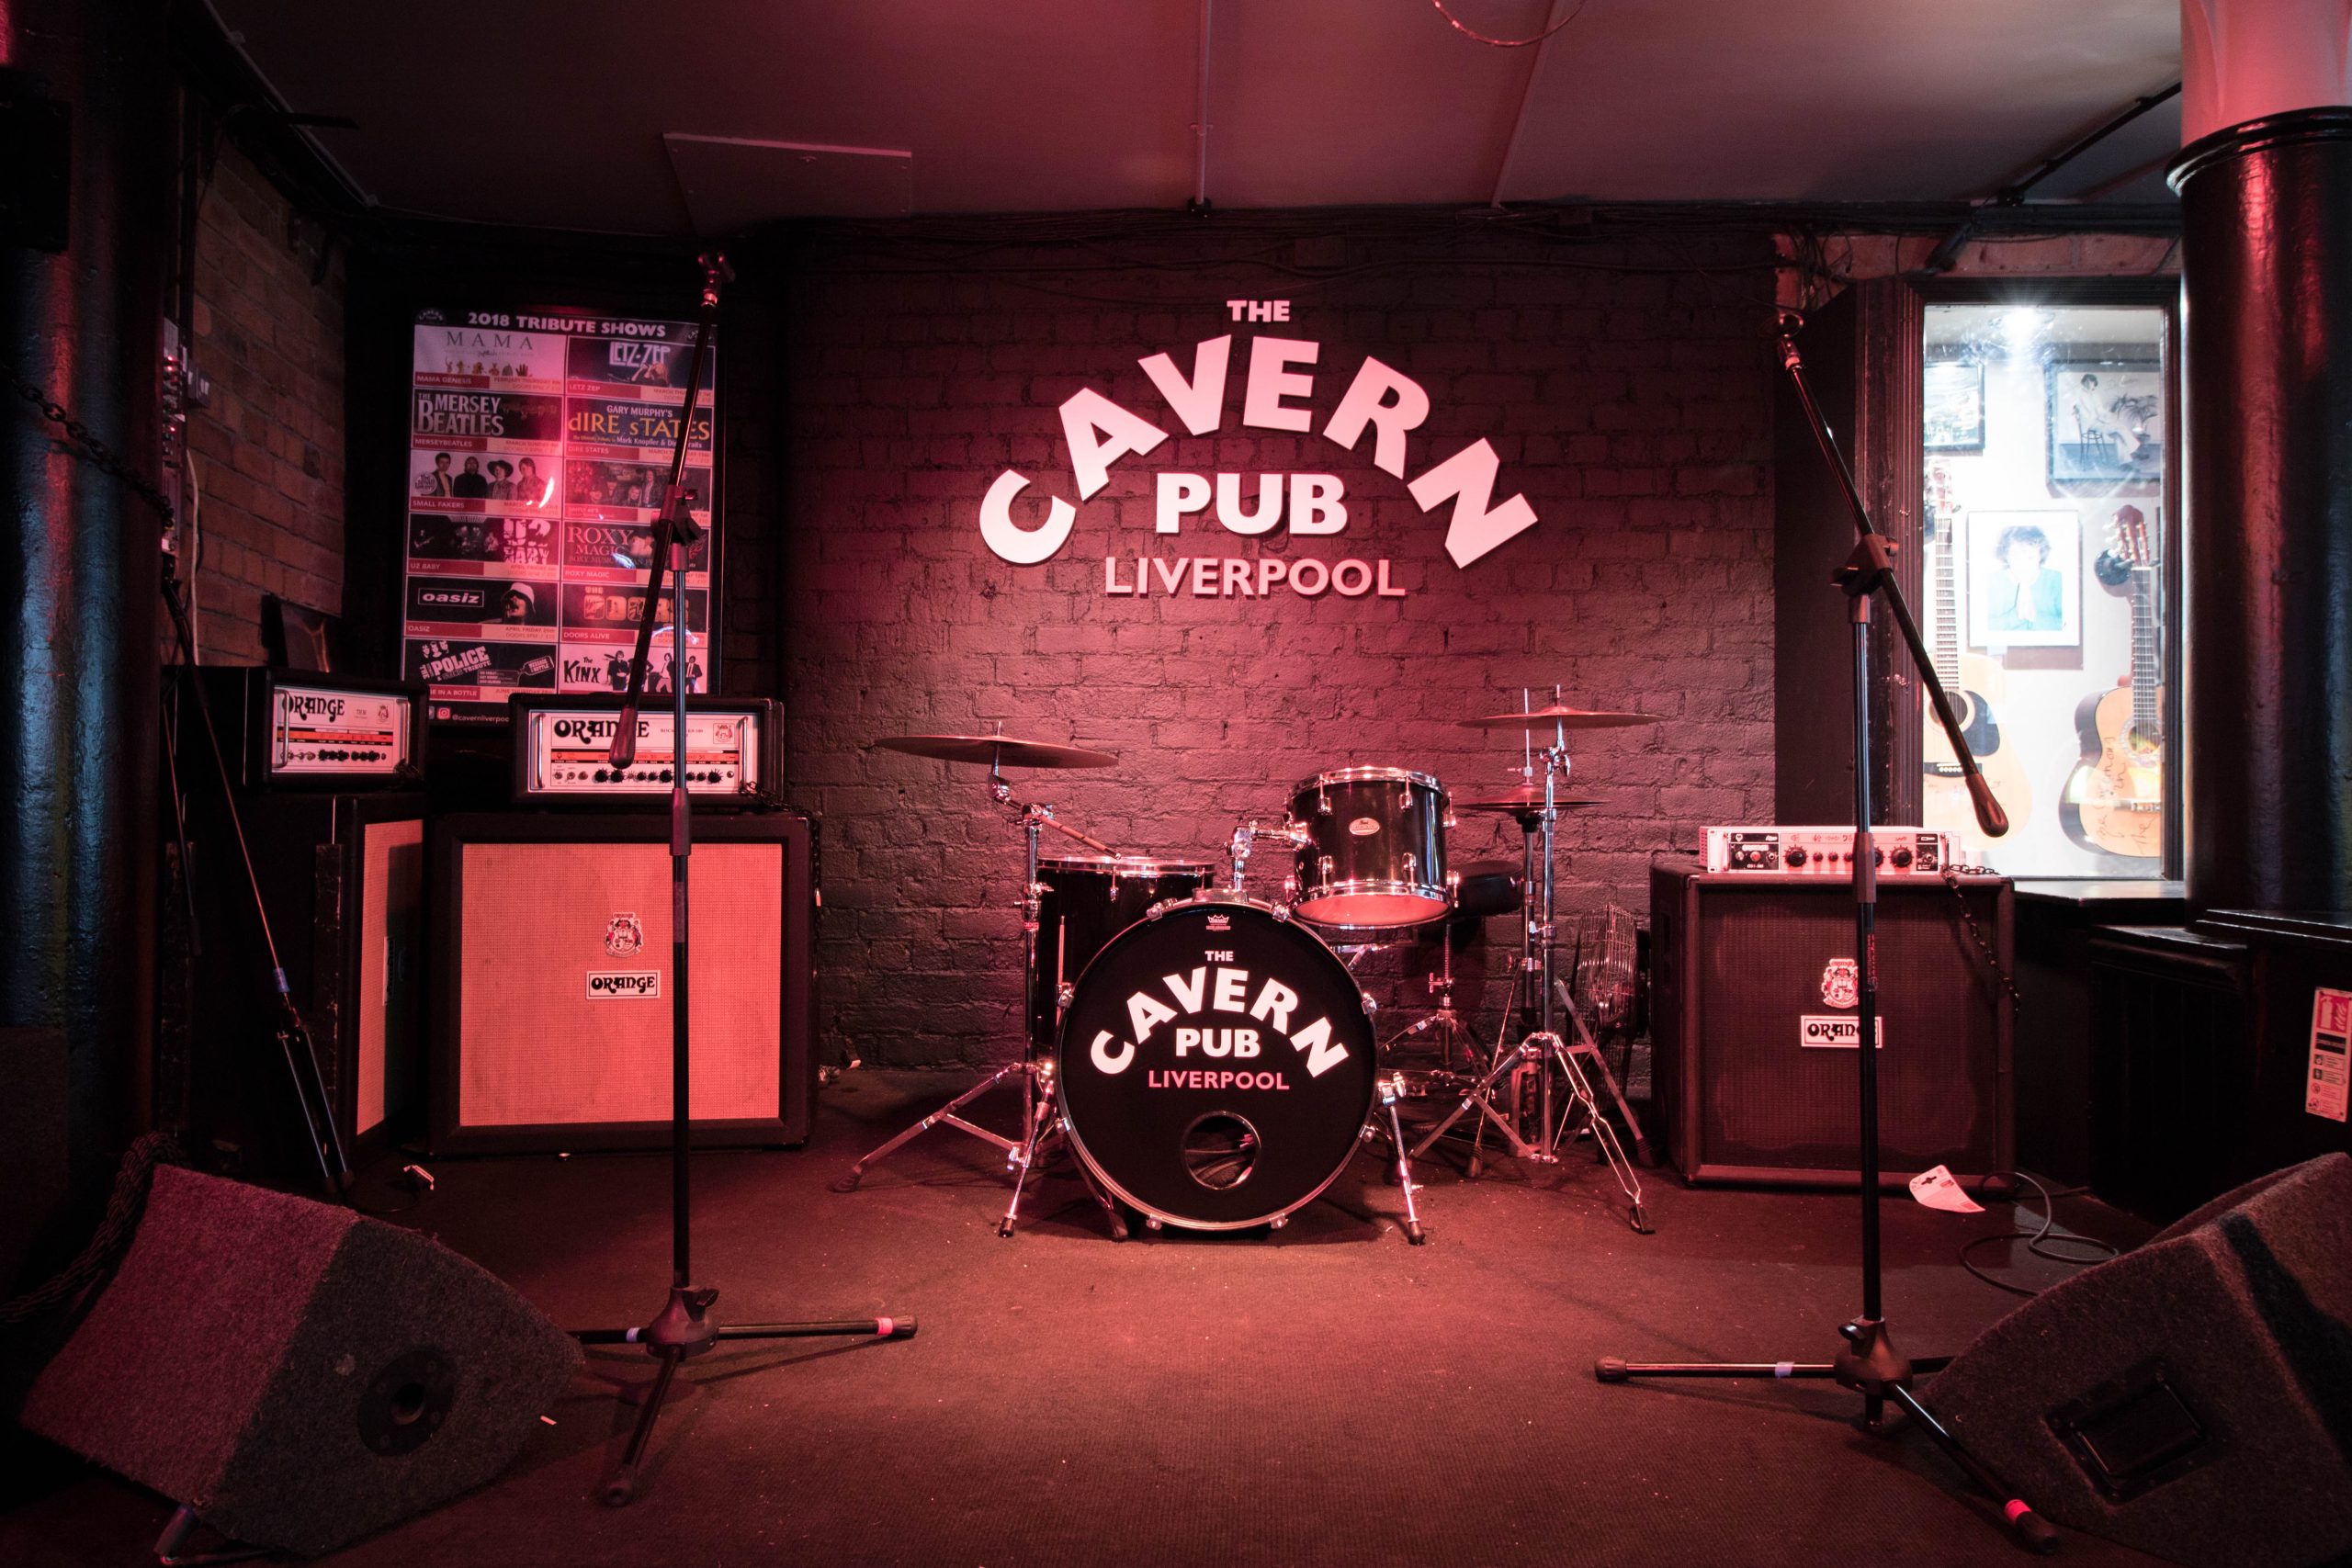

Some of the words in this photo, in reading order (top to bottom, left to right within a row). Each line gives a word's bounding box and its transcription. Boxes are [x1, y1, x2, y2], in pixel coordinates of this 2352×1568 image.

[1227, 300, 1291, 322] THE
[468, 312, 510, 326] 2018
[516, 316, 596, 333] TRIBUTE
[601, 322, 666, 338] SHOWS
[447, 332, 533, 350] MAMA
[417, 376, 441, 384] MAMA
[435, 393, 502, 413] MERSEY
[606, 404, 628, 414] GARY
[630, 407, 673, 418] MURPHY'S
[417, 399, 504, 436] BEATLES
[568, 412, 620, 434] dIRE
[414, 438, 473, 447] MERSEYBEATLES
[616, 435, 633, 444] Mark
[979, 333, 1539, 570] CAVERN
[1155, 472, 1349, 536] PUB
[566, 526, 634, 546] ROXY
[575, 545, 626, 557] MAGIC
[1104, 556, 1407, 598] LIVERPOOL
[422, 592, 480, 604] oasiz
[431, 646, 491, 677] POLICE
[563, 660, 602, 684] KINX
[282, 695, 345, 723] ORANGE
[452, 715, 510, 724] @cavernliverpoo
[554, 719, 650, 745] ORANE
[1204, 950, 1234, 962] THE
[591, 976, 656, 994] ORANGE
[1091, 966, 1350, 1078] CAVERN
[1807, 1023, 1875, 1042] ORAN
[1175, 1028, 1261, 1057] PUB
[1148, 1069, 1290, 1090] LIVERPOOL
